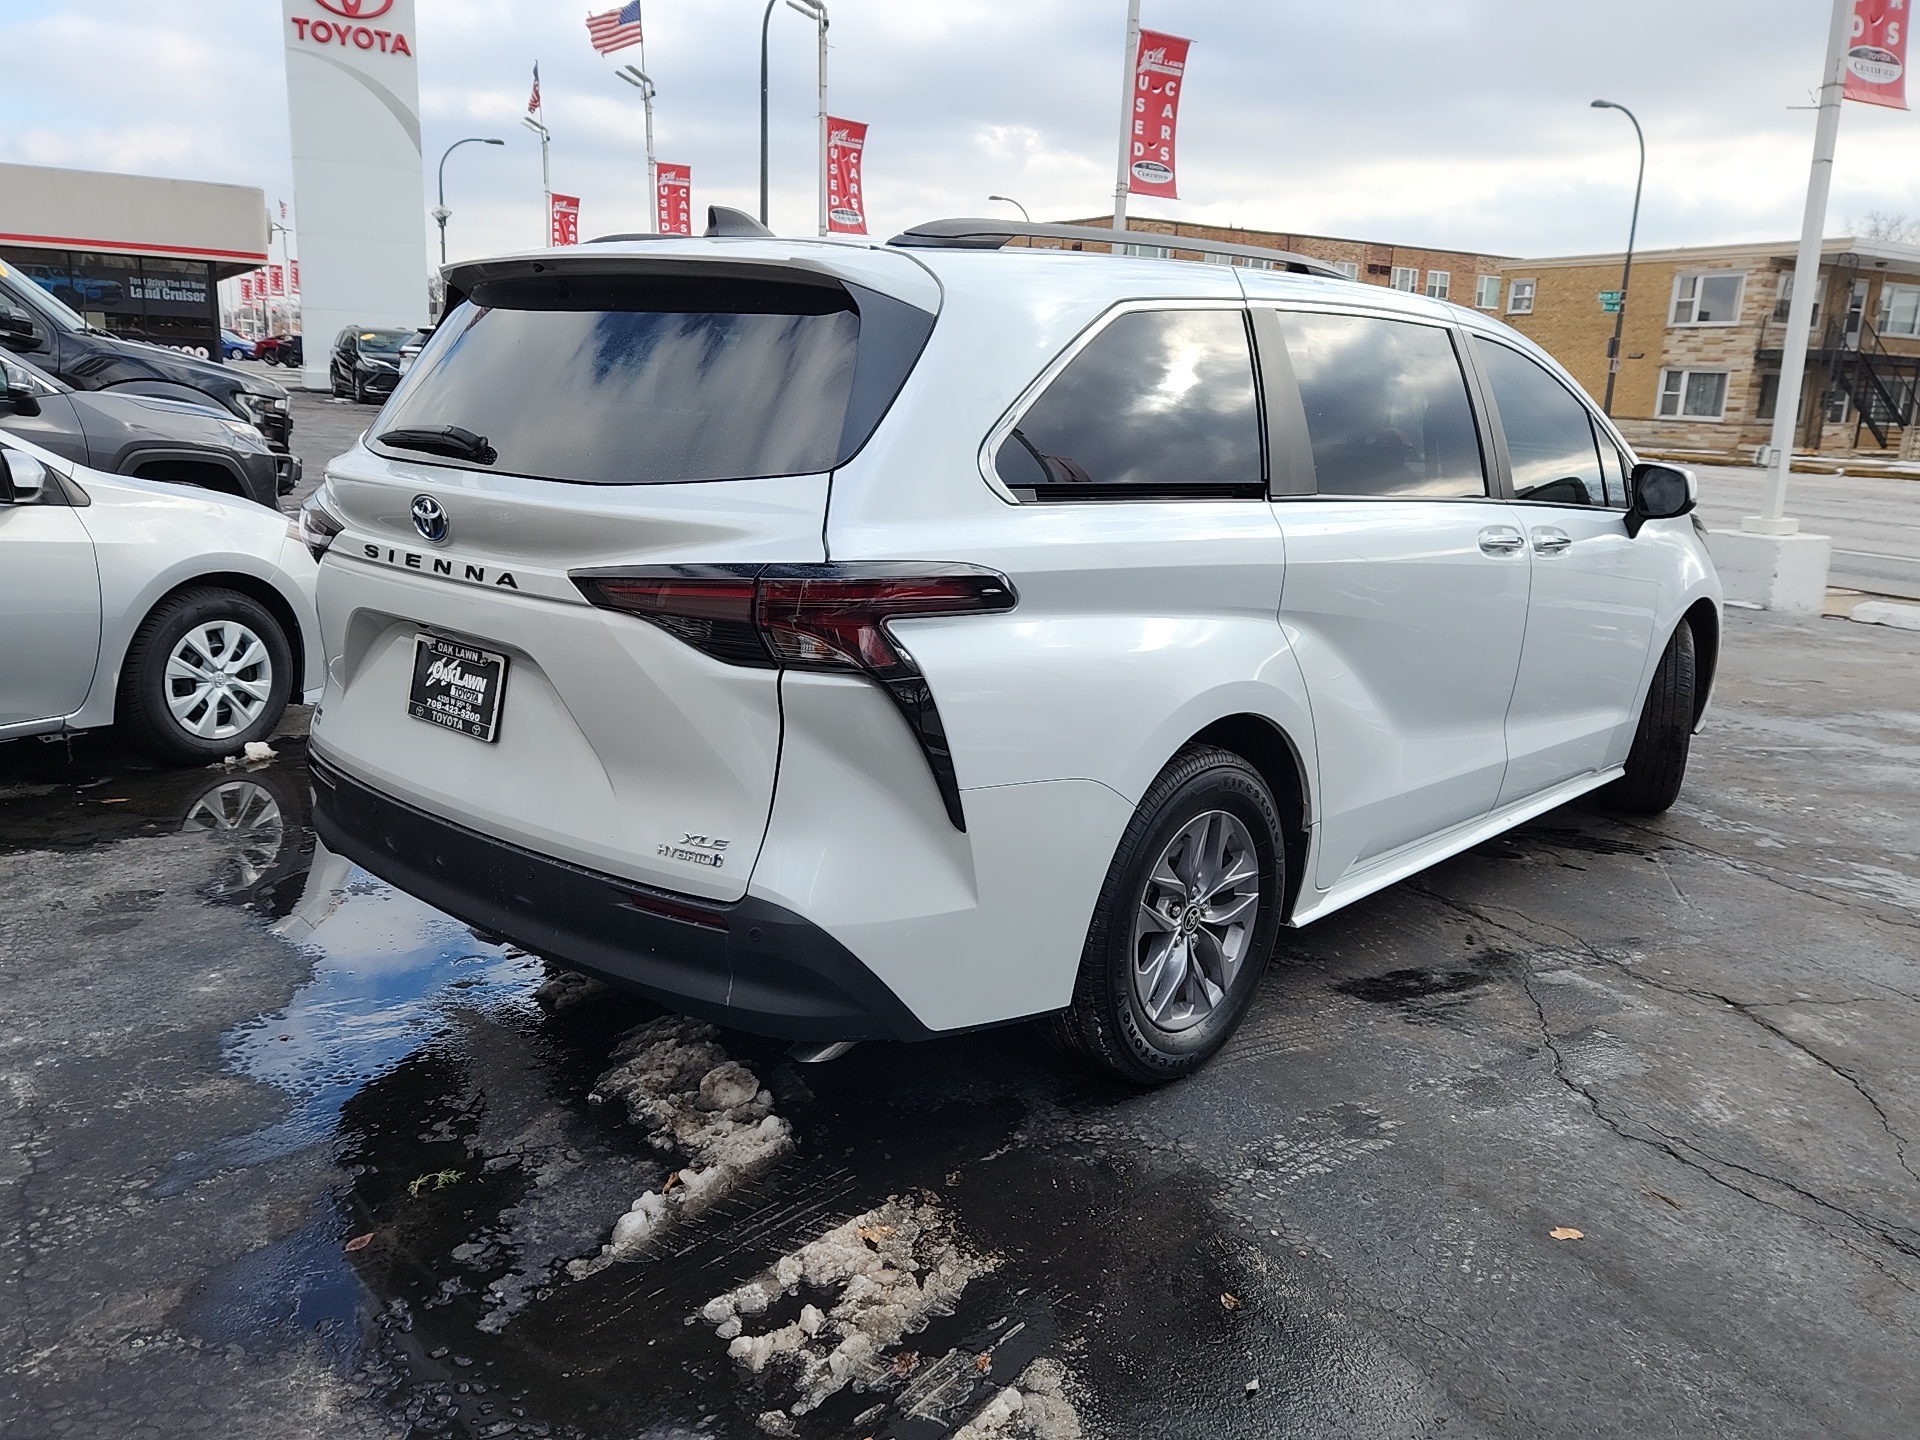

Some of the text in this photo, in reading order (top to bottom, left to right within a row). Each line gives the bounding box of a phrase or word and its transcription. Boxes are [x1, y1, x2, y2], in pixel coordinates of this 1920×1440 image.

[291, 17, 411, 56] TOYOTA
[1854, 62, 1896, 77] CERTIFIED
[1869, 52, 1891, 61] TOYOTA
[1133, 75, 1149, 156] USED
[1160, 81, 1177, 161] CARS
[830, 148, 839, 206] USED
[849, 152, 859, 209] CARS
[660, 186, 670, 231] USED
[679, 188, 688, 233] CARS
[568, 215, 577, 245] CAR
[130, 286, 206, 303] Land Cruiser
[363, 544, 519, 589] SIENNA
[437, 643, 479, 662] OAK LAWN
[454, 687, 480, 703] TOYOTA
[426, 698, 481, 722] 708-423-5200
[431, 711, 463, 730] TOYOTA
[657, 844, 712, 865] HYBRID
[678, 832, 731, 851] XLE
